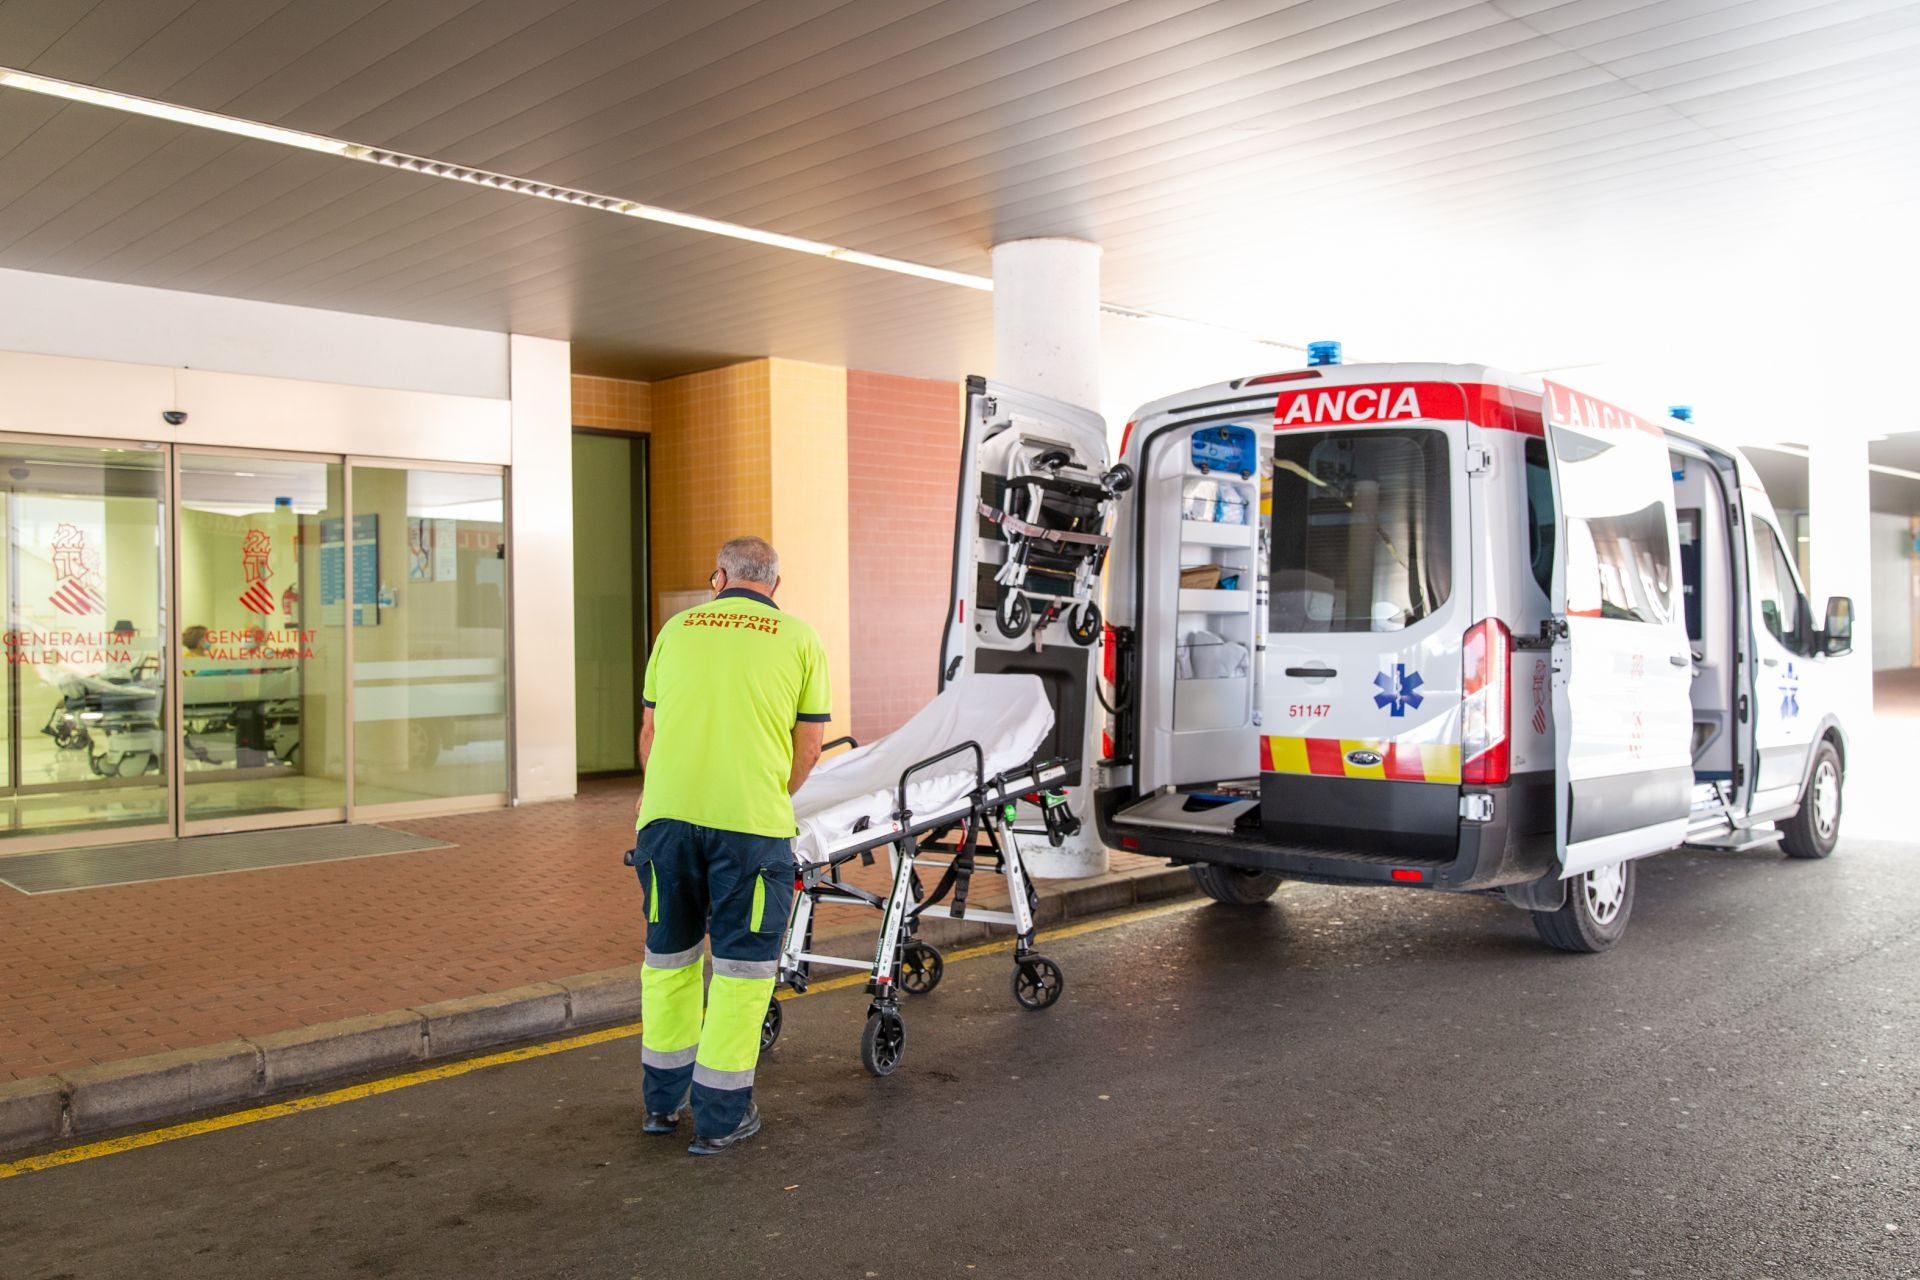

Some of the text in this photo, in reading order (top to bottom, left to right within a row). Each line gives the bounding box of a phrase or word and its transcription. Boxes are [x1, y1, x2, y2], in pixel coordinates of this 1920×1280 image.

[1274, 387, 1421, 425] ANCIA
[687, 612, 781, 626] TRANSPORT
[683, 620, 778, 635] SANITARI
[3, 630, 134, 646] GENERALITAT
[204, 629, 317, 644] GENERALITAT
[5, 649, 132, 665] VALENCIANA
[206, 646, 315, 661] VALENCIANA
[1288, 704, 1331, 718] 51147
